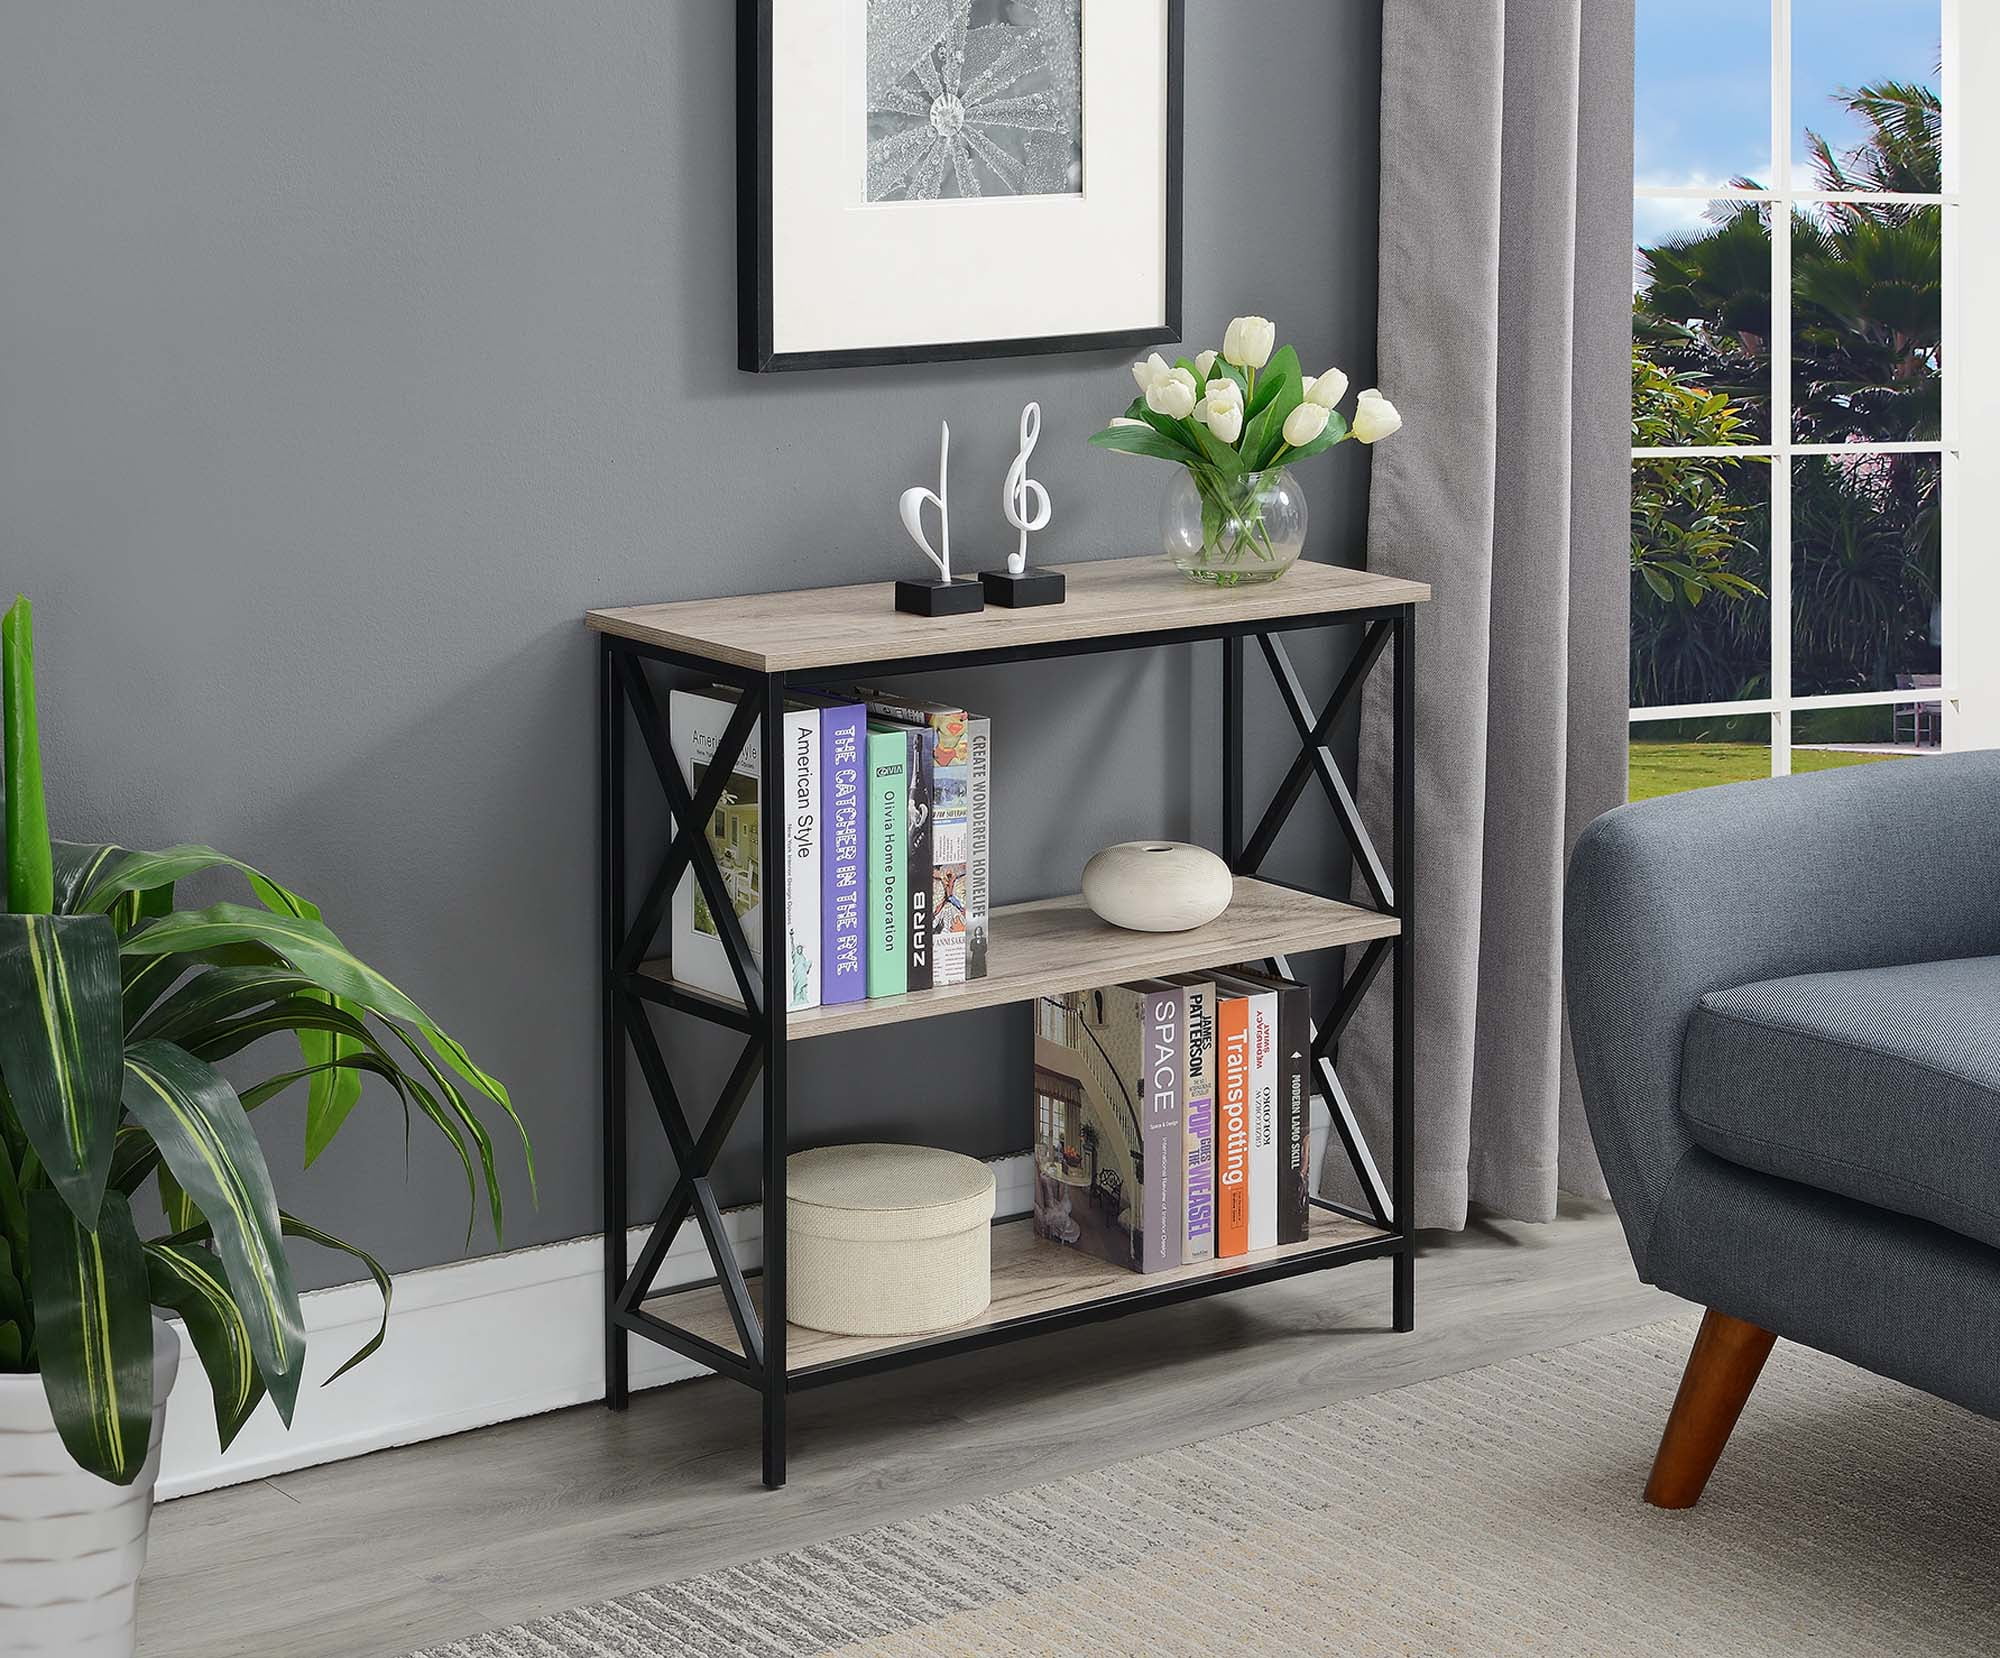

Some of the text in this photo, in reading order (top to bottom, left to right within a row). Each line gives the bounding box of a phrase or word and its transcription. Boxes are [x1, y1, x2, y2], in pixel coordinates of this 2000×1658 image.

[793, 727, 813, 858] American Style
[972, 735, 986, 918] CREATE WONDERFUL HOMELIFE
[835, 725, 858, 975] THE CATCHER IN THE RYE
[884, 791, 896, 952] Olivia Home Decoration
[914, 892, 926, 967] ZARB
[1154, 1001, 1176, 1113] SPACE
[1189, 994, 1203, 1078] PATTERSON
[1202, 1016, 1212, 1051] JAMES
[1188, 1098, 1212, 1140] POP
[1222, 1028, 1248, 1185] Trainspotting
[1291, 1074, 1301, 1170] MODERN LAMO SKILL
[1188, 1148, 1200, 1167] THE
[1201, 1138, 1212, 1162] GOES
[1188, 1162, 1212, 1241] WEASEL
[1160, 1235, 1168, 1258] Design
